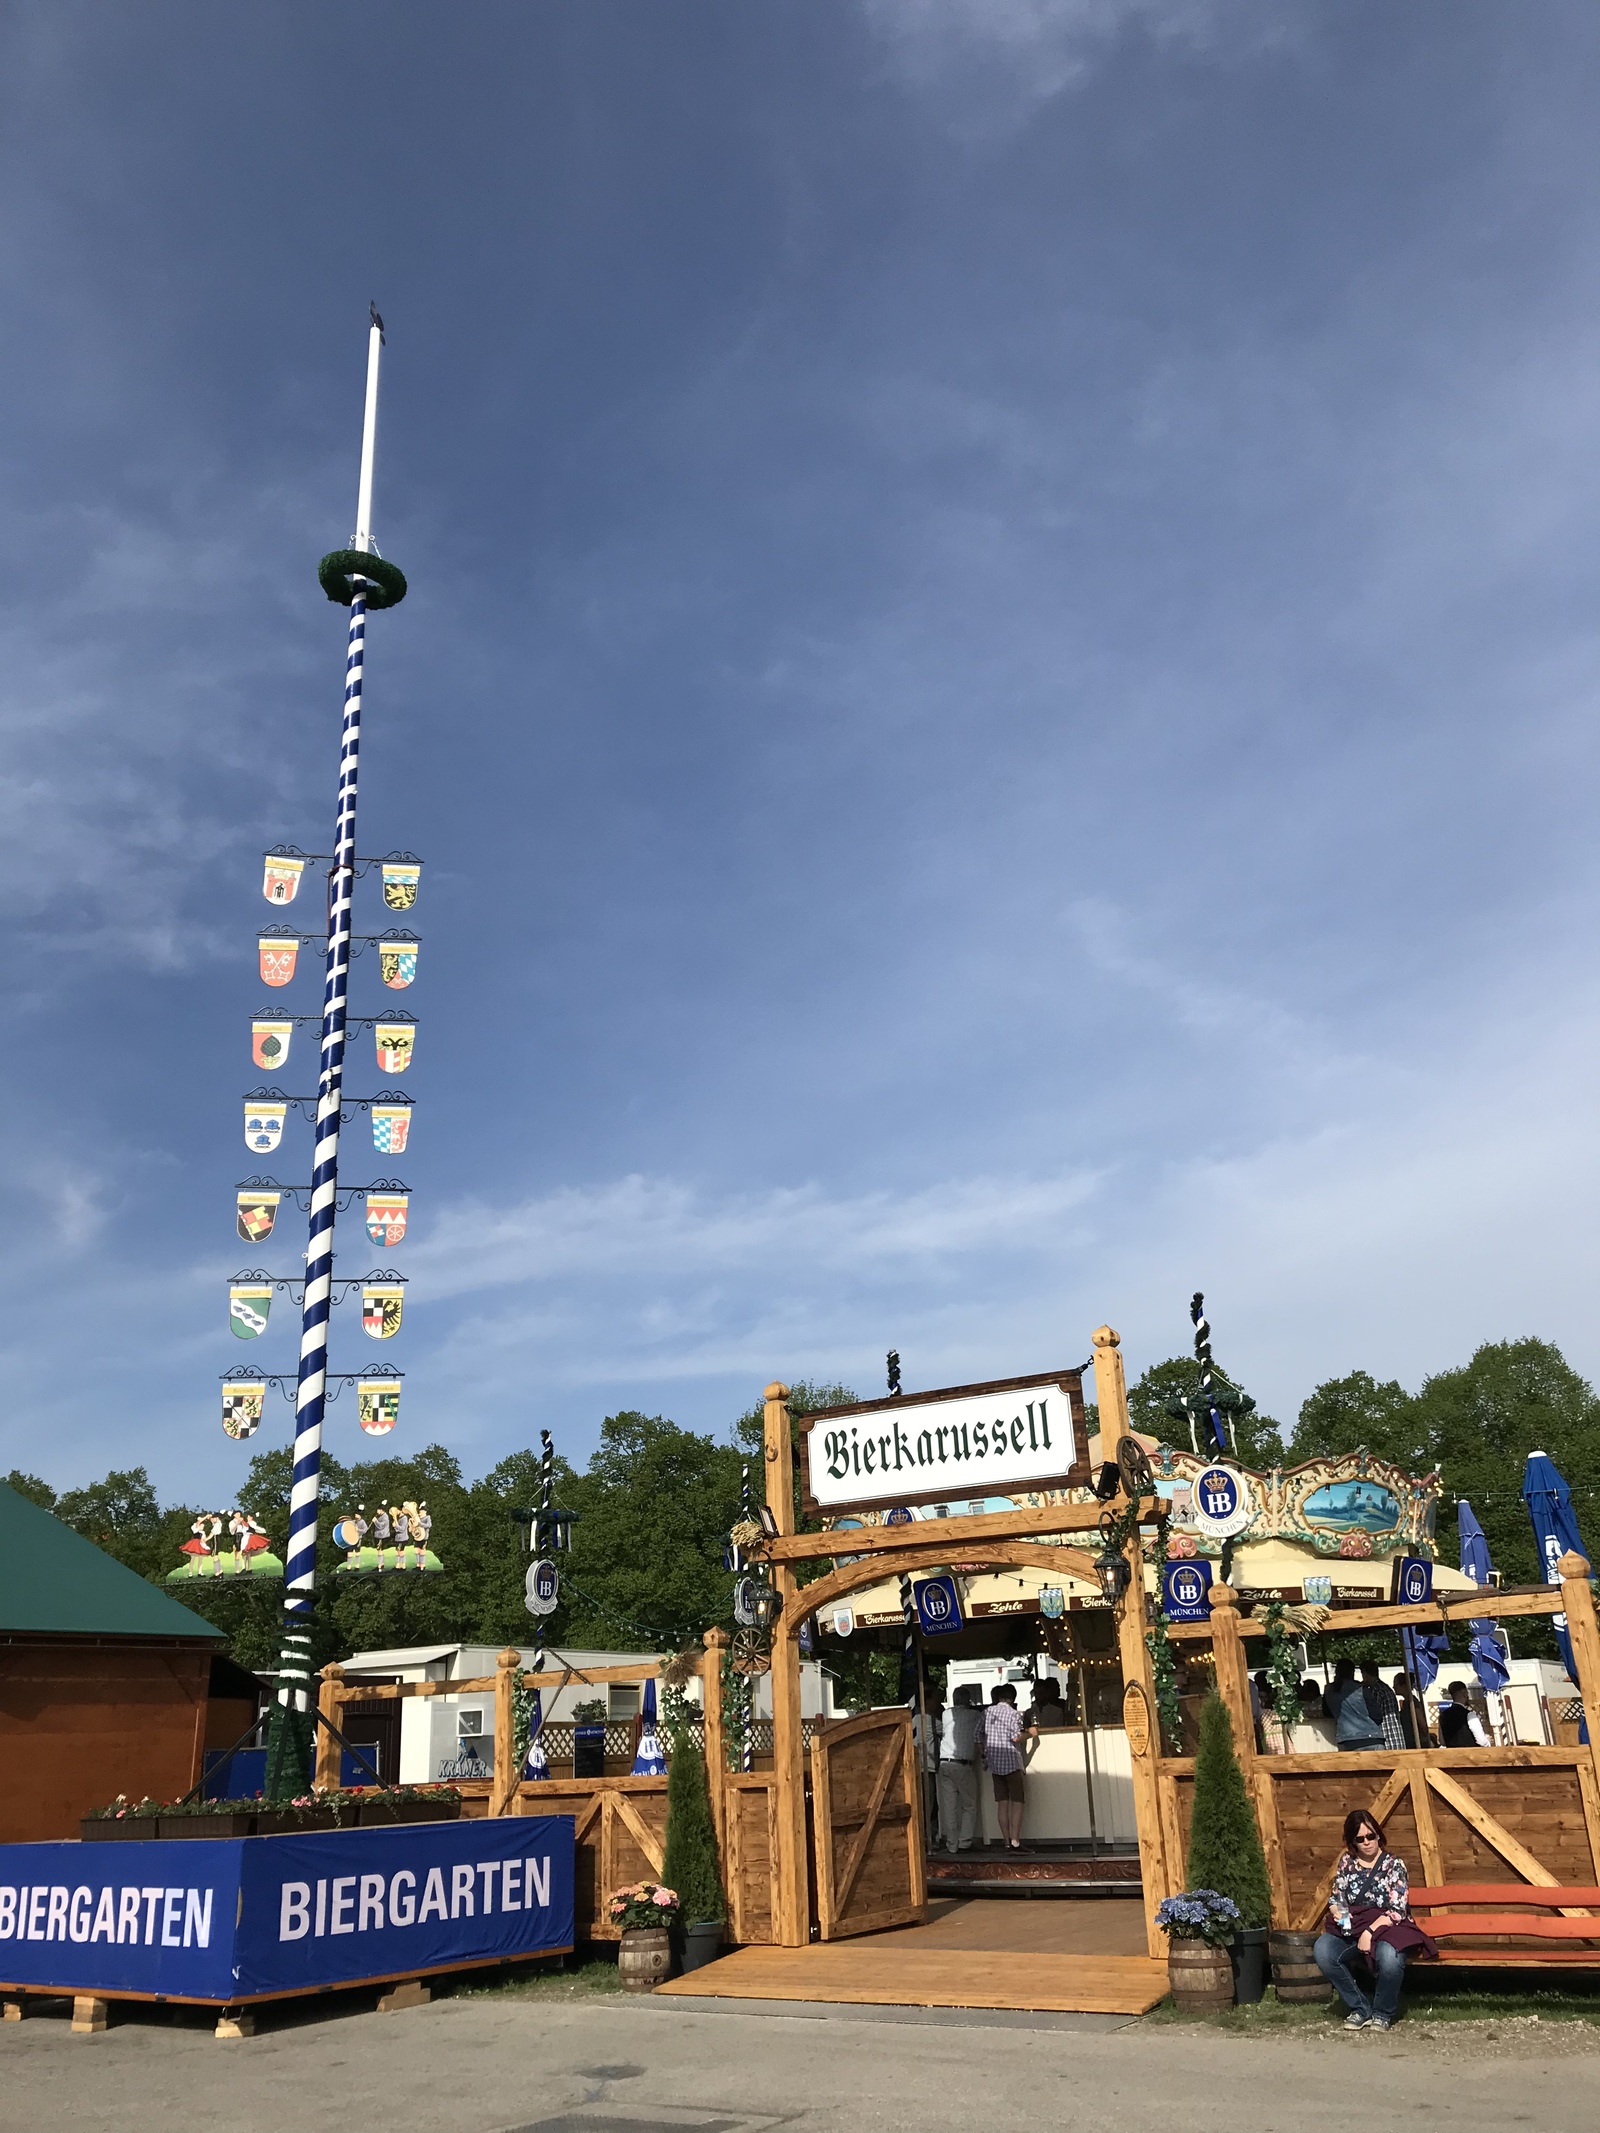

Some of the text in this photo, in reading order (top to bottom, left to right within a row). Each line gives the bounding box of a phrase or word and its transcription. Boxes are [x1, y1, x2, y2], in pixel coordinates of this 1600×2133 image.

[824, 1398, 1053, 1480] Bierkarussell
[1206, 1492, 1232, 1514] HB
[539, 1580, 552, 1596] HB
[1179, 1584, 1198, 1600] HB
[1410, 1581, 1421, 1596] HB
[929, 1600, 946, 1616] HB
[987, 1601, 1023, 1614] Zehle
[1170, 1607, 1209, 1616] MÜNCHEN
[926, 1621, 958, 1632] MÜNCHEN
[438, 1752, 486, 1778] KRÄMER
[278, 1856, 551, 1942] BIERGARTEN
[0, 1886, 214, 1948] BIERGARTEN
